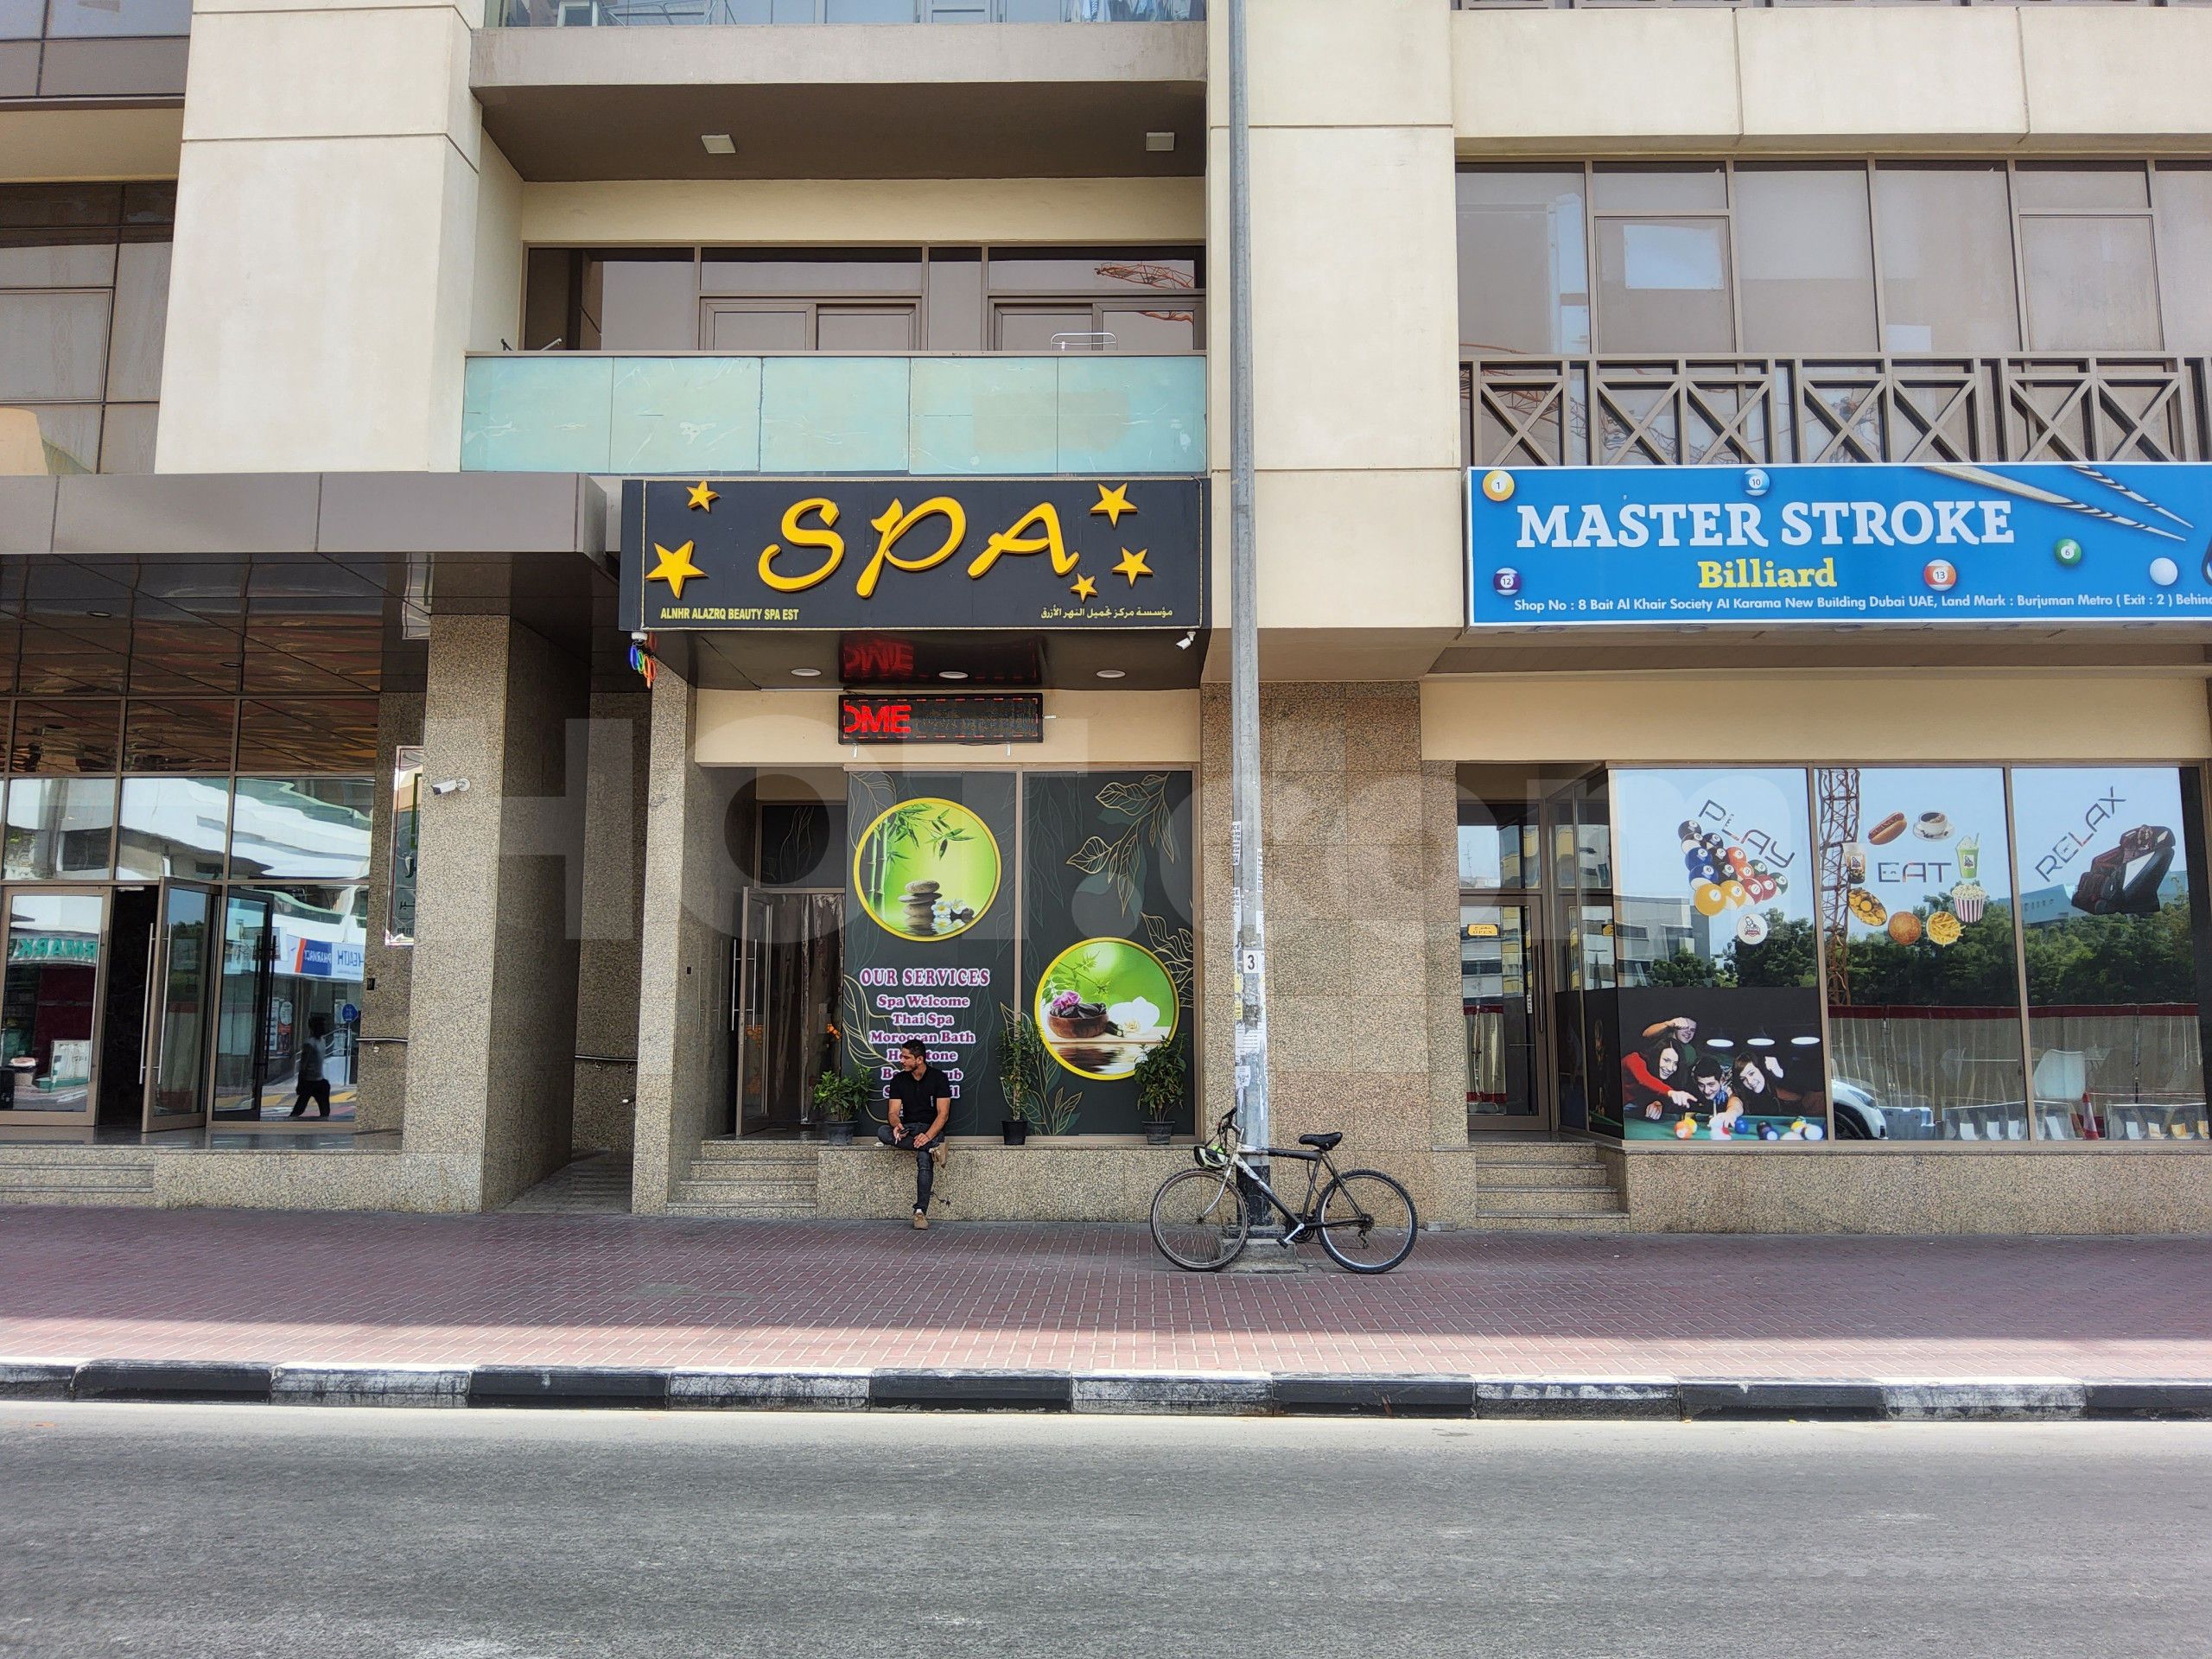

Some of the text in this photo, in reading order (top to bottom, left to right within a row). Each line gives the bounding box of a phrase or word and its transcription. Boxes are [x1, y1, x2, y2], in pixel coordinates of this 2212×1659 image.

[1751, 478, 1761, 486] 10
[1516, 500, 2015, 548] MASTER STROKE
[758, 495, 1080, 598] SPA
[1698, 557, 1838, 588] Billiard
[1935, 570, 1946, 581] 13
[1501, 577, 1511, 586] 12
[1514, 599, 1545, 613] Shop
[1548, 599, 1567, 611] No
[1578, 599, 1586, 610] 8
[1590, 598, 1613, 610] Bait
[1617, 598, 1630, 610] Al
[1634, 598, 1667, 610] Khair
[1670, 598, 1713, 613] Society
[1716, 597, 1730, 609] Al
[1733, 597, 1781, 608] Karama
[1785, 597, 1813, 608] New
[1817, 596, 1866, 610] Building
[1870, 595, 1905, 607] Dubai
[1909, 595, 1937, 608] UAE,
[1942, 594, 1971, 607] Land
[1974, 594, 2005, 607] Mark
[2017, 594, 2074, 609] Burjuman
[2077, 594, 2113, 606] Metro
[2124, 594, 2146, 606] Exit
[2157, 594, 2164, 605] 2
[660, 607, 799, 620] ALNHR ALAZRQ BEAUTY SPA EST
[1063, 607, 1085, 619] النهر
[1086, 606, 1112, 619] تجميل
[1113, 607, 1135, 619] مركز
[1135, 606, 1173, 619] مؤسسة
[1698, 799, 1795, 868] PLAY
[2035, 785, 2126, 882] RELAX
[1878, 861, 1952, 883] EAT
[1248, 954, 1255, 970] 3
[860, 968, 990, 986] OUR SERVICES
[877, 995, 970, 1009] Spa Welcome
[893, 1012, 955, 1027] Thai Spa
[940, 1030, 976, 1044] Bath
[925, 1050, 958, 1062] tone
